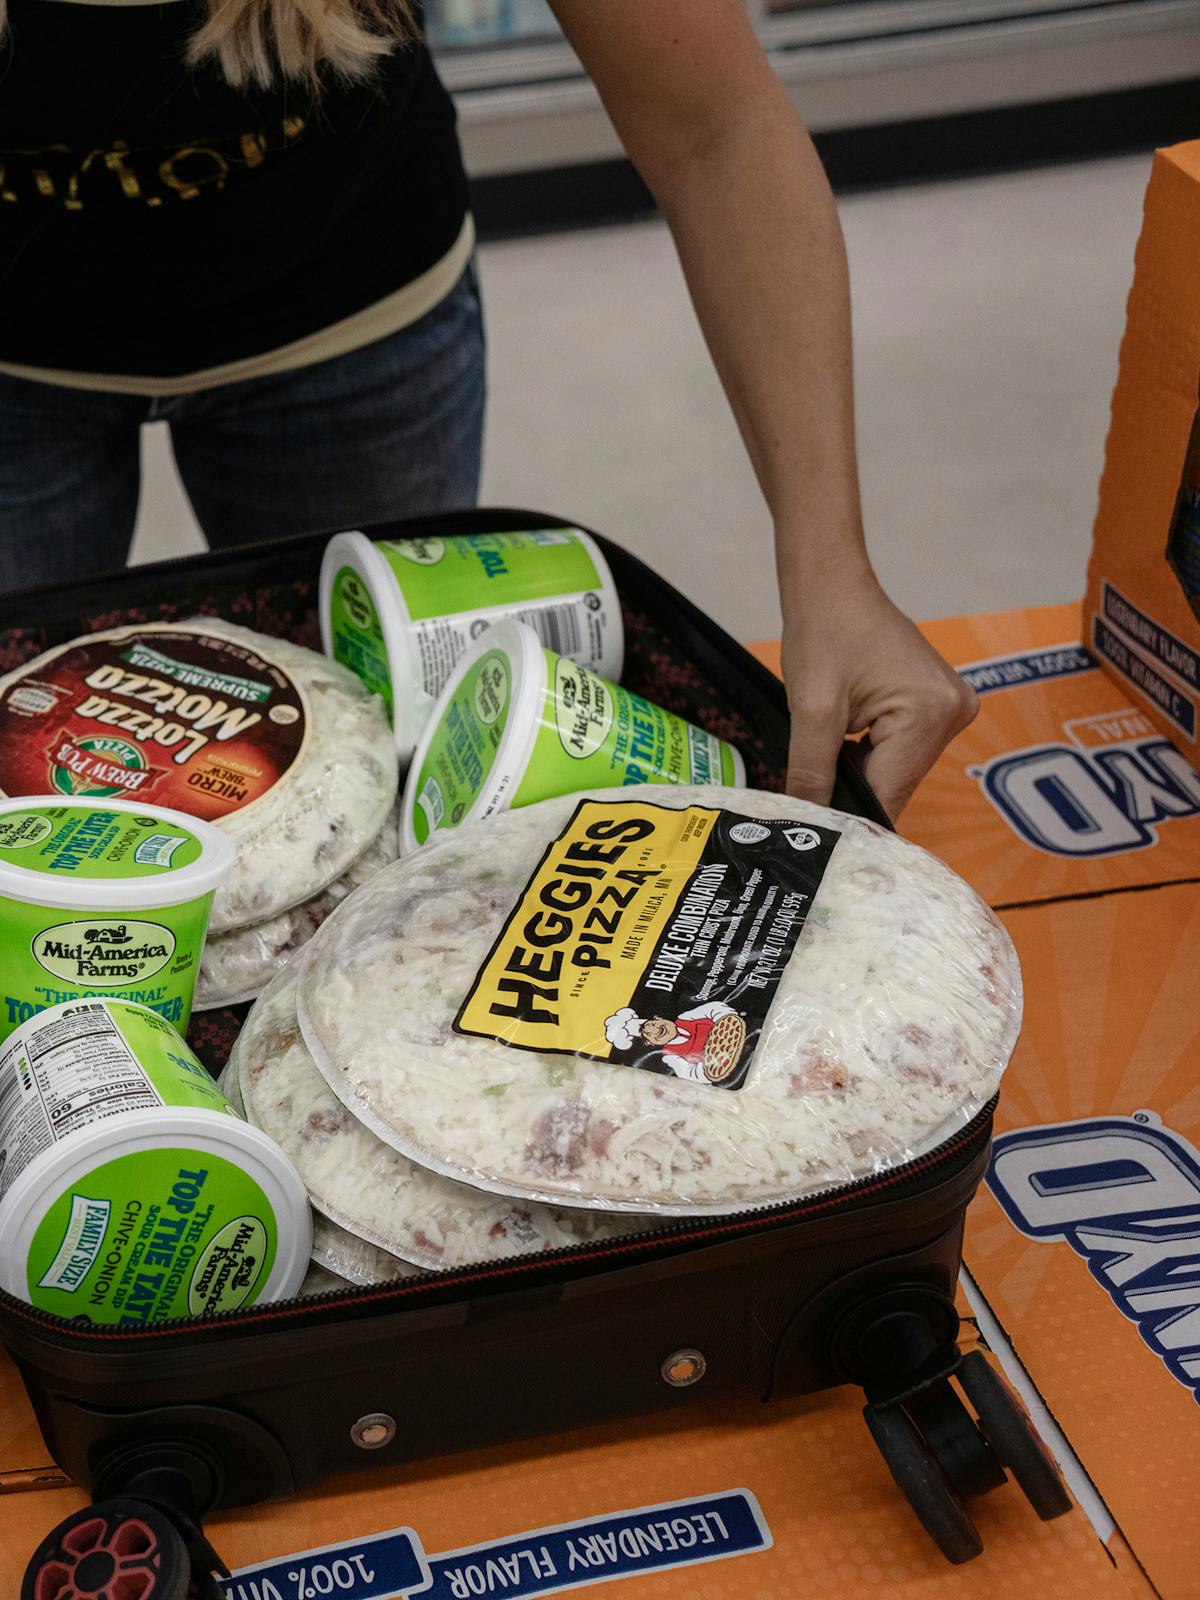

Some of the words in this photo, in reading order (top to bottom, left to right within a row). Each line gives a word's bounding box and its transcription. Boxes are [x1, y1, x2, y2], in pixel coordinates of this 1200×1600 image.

[129, 652, 175, 674] PIZZA
[176, 668, 261, 700] SUPREME
[85, 664, 261, 740] Motzza
[74, 695, 208, 764] Lotzza
[630, 720, 655, 762] THE
[57, 743, 89, 773] PUB
[93, 740, 136, 761] PIZZA
[91, 758, 149, 790] BREW
[187, 773, 248, 801] MICRO
[62, 836, 97, 854] THE
[48, 853, 84, 870] TOP
[655, 878, 673, 889] MN
[746, 867, 763, 889] Pepper
[638, 893, 668, 922] MILACA,
[711, 899, 731, 917] PIZZA
[740, 887, 756, 902] Green
[489, 818, 655, 1026] HEGGIES
[632, 924, 649, 934] IN
[644, 942, 691, 993] DELUXE
[668, 863, 729, 943] COMBINATION
[699, 917, 722, 940] CRUST
[42, 940, 168, 961] Mid-America
[620, 935, 643, 960] MADE
[689, 935, 712, 958] THIN
[762, 944, 782, 957] OZ
[570, 971, 590, 997] SINCE
[89, 1081, 146, 1097] Calories
[51, 1103, 72, 1119] 60
[167, 1169, 208, 1214] TOP
[75, 1205, 107, 1255] FAMILY
[138, 1204, 161, 1239] SOUR
[144, 1218, 188, 1267] THE
[57, 1255, 91, 1285] SIZE
[120, 1242, 145, 1285] CREAM
[112, 1288, 127, 1309] DIP
[567, 1511, 730, 1572] LEGENDARY
[287, 1554, 375, 1600] 100%
[444, 1546, 558, 1599] FLAVOR
